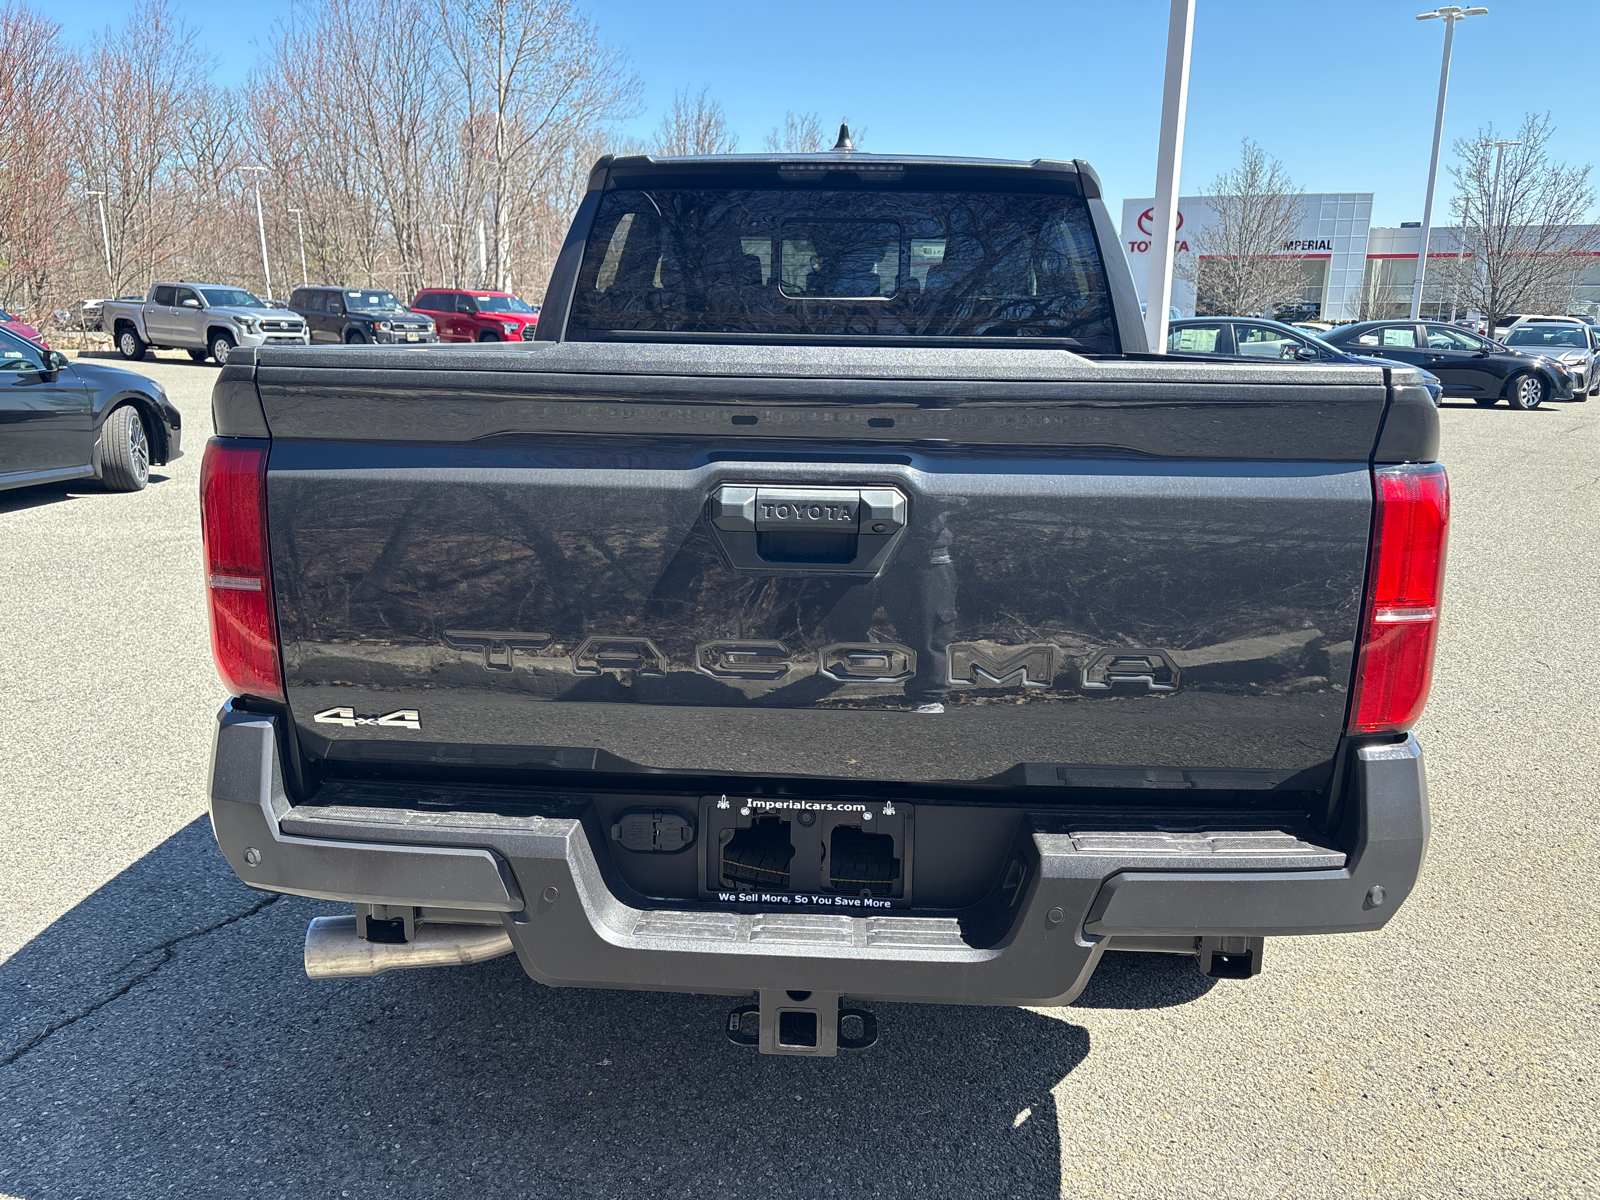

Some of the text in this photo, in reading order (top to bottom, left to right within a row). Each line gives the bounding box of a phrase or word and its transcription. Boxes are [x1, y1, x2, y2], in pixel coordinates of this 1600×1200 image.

[1128, 241, 1189, 253] TOA
[761, 503, 852, 521] TOYOTA
[443, 629, 1181, 690] TACOMA
[746, 798, 866, 812] Imperialcars.com
[718, 892, 891, 908] We Sell More, So You Save More
